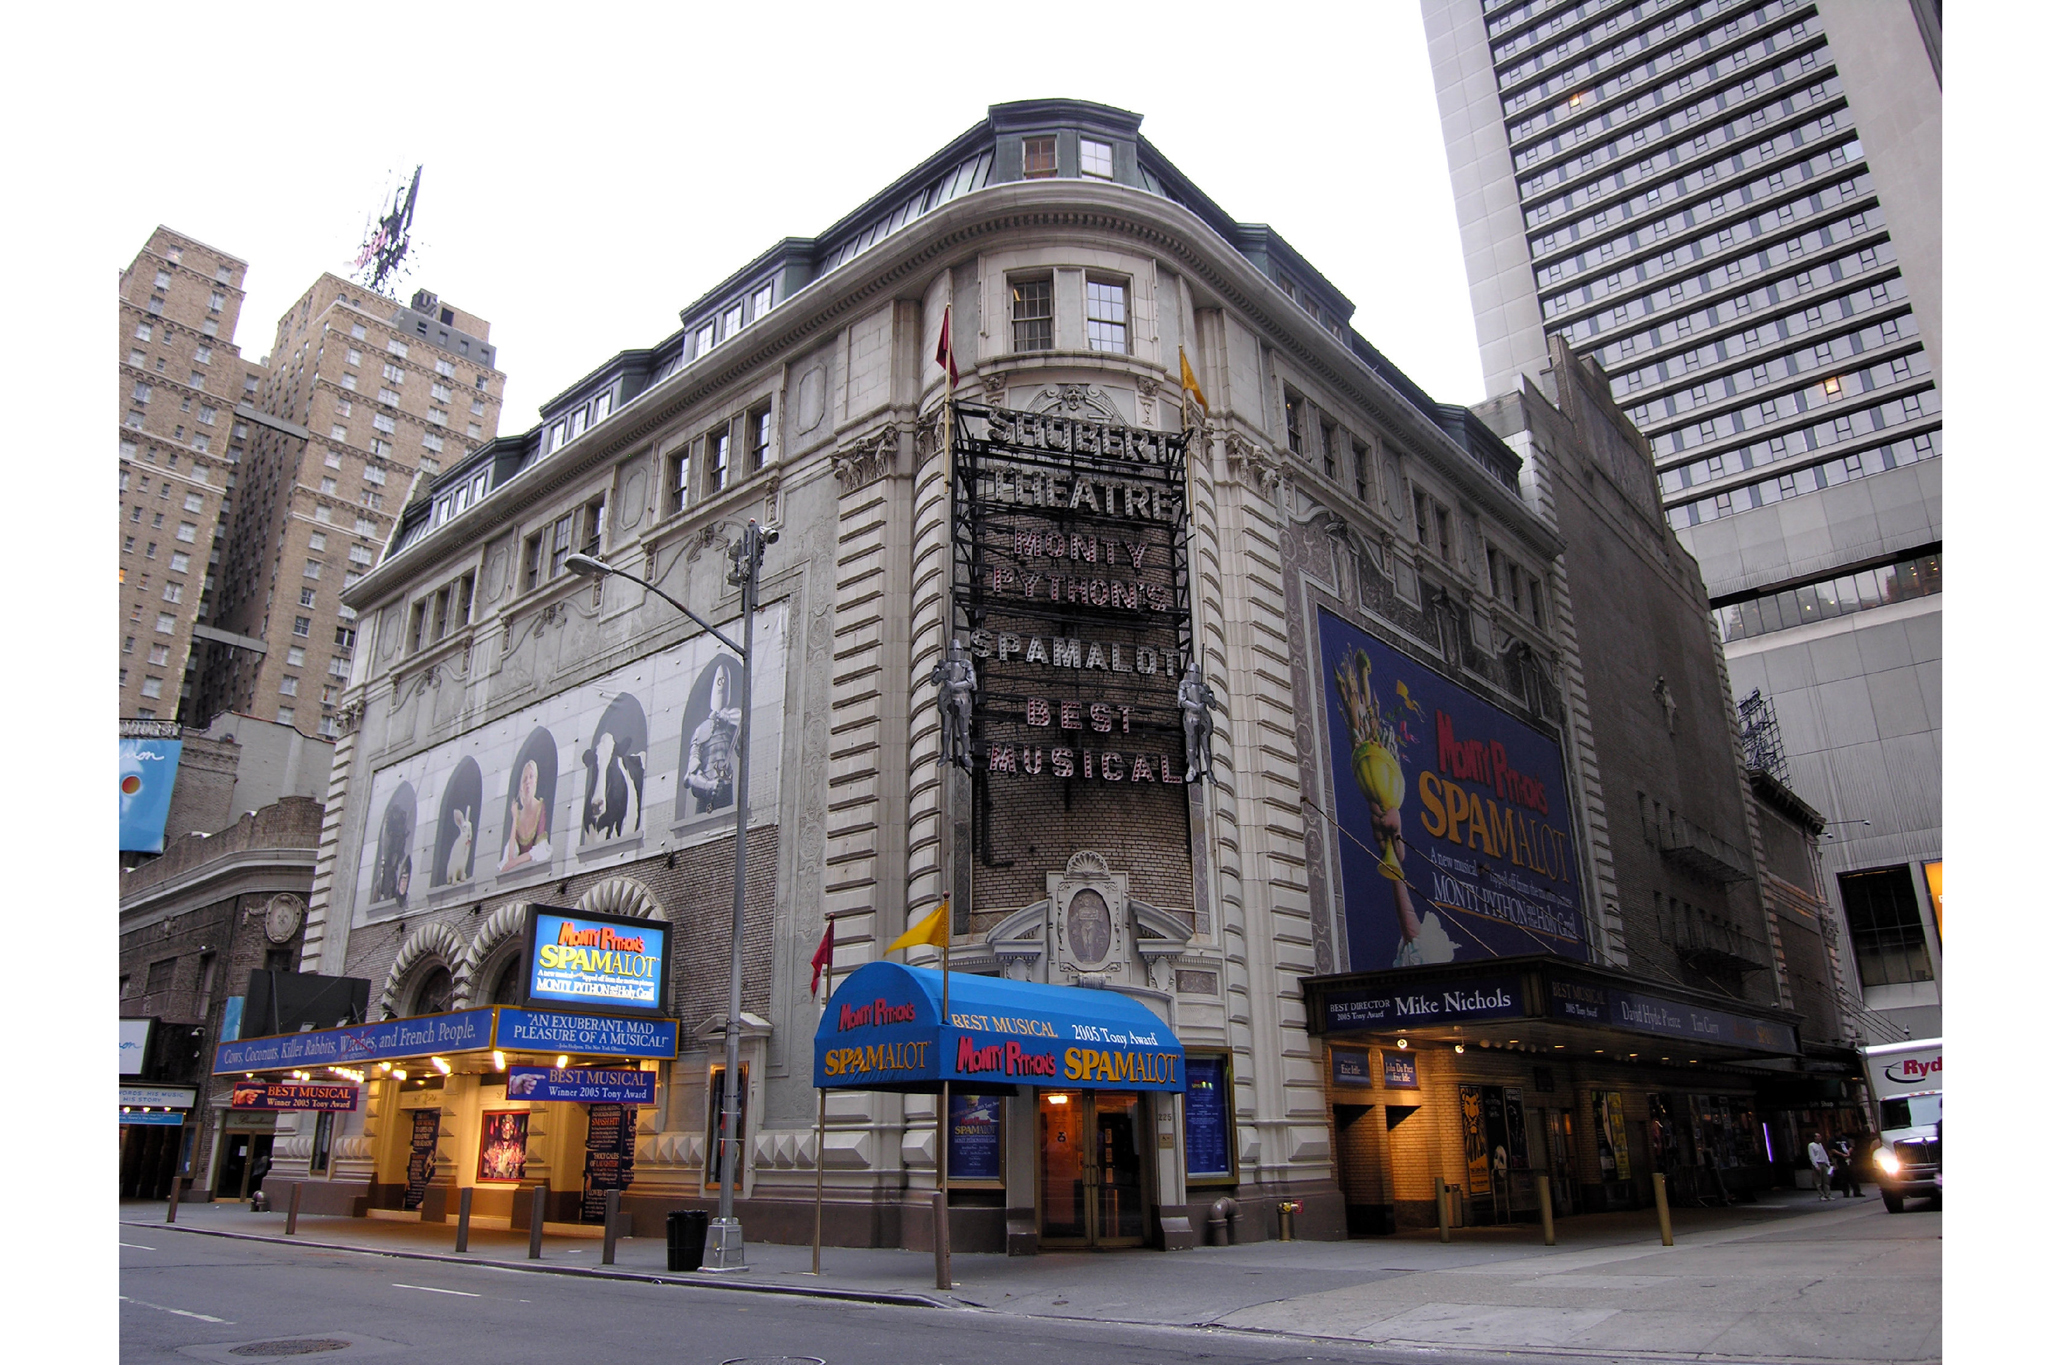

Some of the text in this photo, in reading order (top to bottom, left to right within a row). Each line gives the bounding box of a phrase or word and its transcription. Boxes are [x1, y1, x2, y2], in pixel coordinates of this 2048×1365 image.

[987, 408, 1174, 465] SHUBERT
[993, 466, 1174, 521] THEATRE
[1013, 528, 1148, 569] MONTY
[993, 566, 1167, 612] PYTHON'S
[970, 628, 1180, 677] SPAMALOT
[1026, 697, 1136, 734] BEST
[989, 741, 1183, 784] MUSICAL
[1418, 770, 1570, 885] SPAMALOT
[1430, 846, 1438, 864] A
[1438, 853, 1453, 868] new
[1453, 858, 1478, 877] musical
[1432, 871, 1480, 912] MONTY
[1482, 887, 1528, 926] PYTHON
[1537, 905, 1558, 941] Holy
[1557, 912, 1579, 940] Grail
[538, 944, 657, 978] SPAMALOT
[536, 977, 572, 990] MONTY
[573, 980, 610, 995] PYTHON
[1552, 981, 1572, 999] BEST
[1330, 998, 1391, 1013] BEST DIRECTOR
[1337, 1010, 1385, 1021] 2005 Tony Award
[1394, 988, 1512, 1017] Mike Nichols
[1620, 1000, 1643, 1023] David
[1641, 1004, 1662, 1031] Hyde
[280, 1038, 304, 1059] Killer
[304, 1035, 337, 1056] Rabbits,
[379, 1027, 399, 1048] and
[400, 1023, 436, 1047] French
[513, 1025, 576, 1042] PLEASURE
[579, 1030, 597, 1043] OF
[599, 1032, 612, 1045] A
[627, 1022, 654, 1035] MAD
[951, 1013, 1159, 1049] BEST MUSICAL 2005 Tony Award
[824, 1041, 928, 1077] SPAMALOT
[1063, 1046, 1178, 1084] SPAMALOT
[267, 1086, 351, 1099] BEST MUSICAL
[548, 1085, 647, 1101] Winner 2005 Tony Award
[549, 1069, 647, 1087] BEST MUSICAL
[266, 1097, 350, 1109] Winner 2005 Tony Award
[1158, 1113, 1172, 1121] 225
[954, 1125, 998, 1135] SPAMALOT
